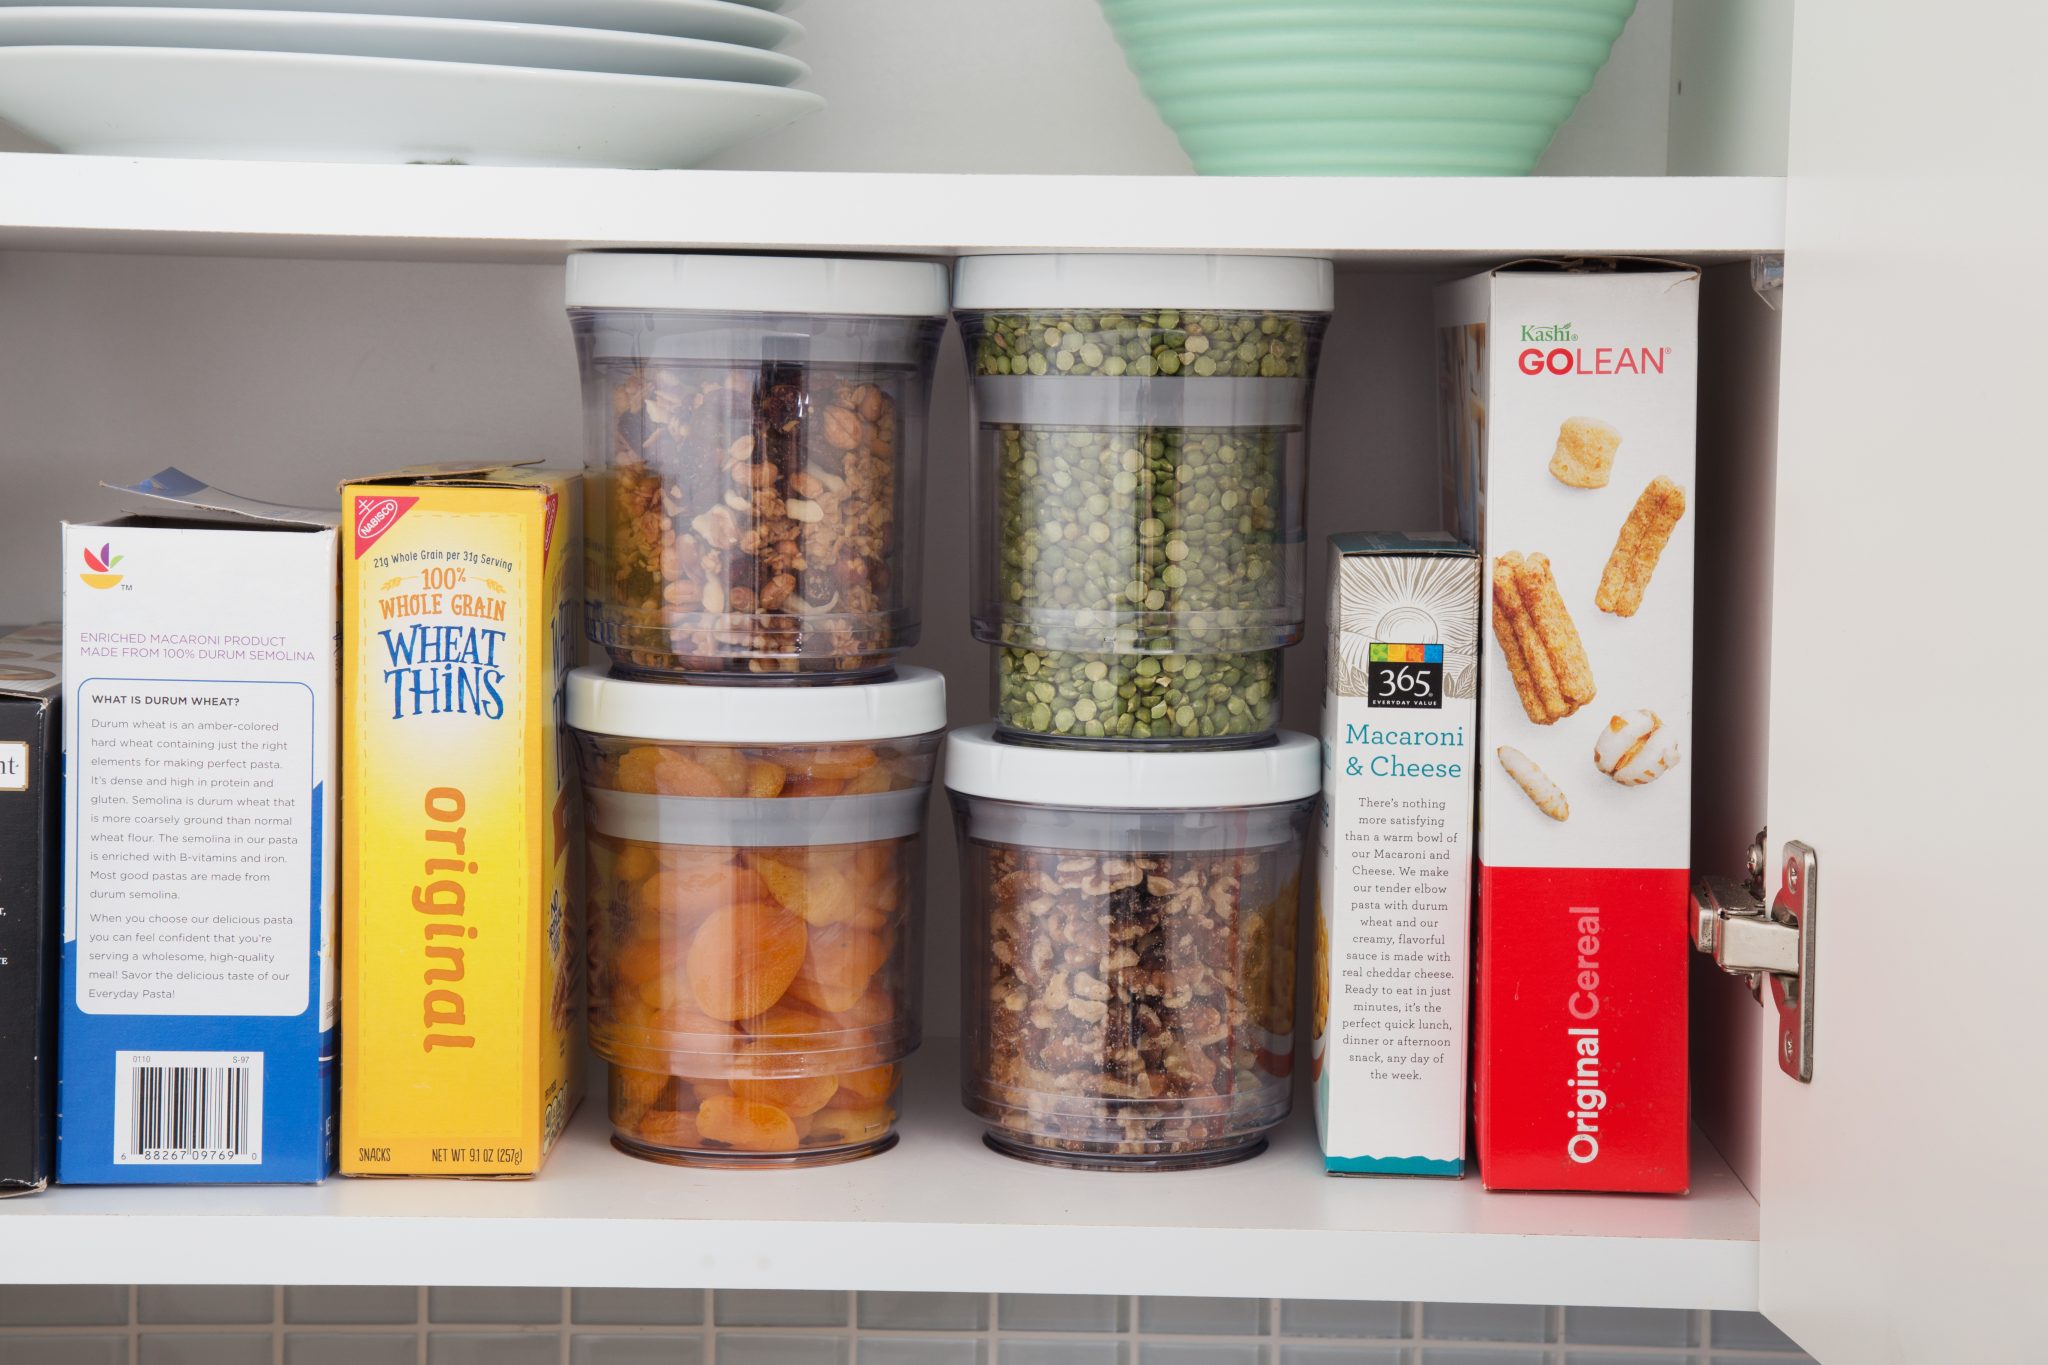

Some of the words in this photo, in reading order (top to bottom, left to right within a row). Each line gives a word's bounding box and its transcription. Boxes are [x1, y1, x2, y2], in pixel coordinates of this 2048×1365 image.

[360, 502, 395, 536] NABISCO
[373, 557, 389, 569] 21g
[391, 551, 418, 565] Whole
[420, 550, 443, 561] Grain
[446, 551, 460, 562] per
[463, 551, 478, 565] 31g
[480, 553, 513, 573] Serving
[420, 567, 467, 591] 100%
[379, 593, 443, 621] WHOLE
[451, 593, 507, 622] GRAIN
[80, 632, 147, 644] ENRICHED
[150, 633, 220, 646] MACARONI
[224, 635, 287, 647] PRODUCT
[377, 623, 506, 669] WHEAT
[80, 646, 119, 657] MADE
[122, 647, 160, 658] FROM
[162, 648, 195, 659] 100%
[198, 649, 246, 662] DURUM
[249, 650, 316, 662] SEMOLINA
[91, 694, 128, 705] WHAT
[130, 695, 142, 705] IS
[144, 695, 188, 706] DURUM
[190, 696, 241, 707] WHEAT?
[91, 718, 129, 729] Durum
[132, 719, 167, 730] wheat
[169, 719, 178, 730] is
[180, 722, 195, 730] an
[197, 721, 279, 732] amber-colored
[1345, 723, 1465, 747] Macaroni
[91, 737, 116, 747] hard
[119, 738, 154, 748] wheat
[156, 739, 215, 751] containing
[217, 740, 238, 751] just
[240, 740, 259, 750] the
[262, 741, 288, 752] right
[90, 756, 142, 767] elements
[144, 757, 161, 767] for
[163, 758, 204, 770] making
[207, 758, 247, 770] perfect
[250, 760, 283, 771] pasta.
[1346, 756, 1363, 777] &
[1370, 755, 1462, 778] Cheese
[1358, 796, 1399, 808] There's
[1401, 797, 1446, 812] nothing
[1358, 817, 1387, 825] more
[1390, 814, 1445, 828] satisfying
[1344, 830, 1370, 842] than
[1373, 834, 1380, 842] a
[1383, 834, 1414, 843] warm
[1416, 831, 1443, 843] bowl
[1446, 832, 1459, 844] of
[1351, 851, 1371, 859] our
[1373, 848, 1427, 860] Macaroni
[1429, 848, 1451, 861] and
[90, 870, 117, 880] Most
[119, 871, 149, 882] good
[152, 872, 188, 882] pastas
[190, 873, 208, 881] are
[210, 872, 242, 882] made
[244, 871, 271, 882] from
[1351, 864, 1396, 877] Cheese.
[1398, 866, 1417, 877] We
[1419, 865, 1449, 878] make
[89, 889, 126, 899] durum
[128, 890, 180, 900] semolina.
[1352, 881, 1373, 893] our
[1375, 882, 1412, 894] tender
[1414, 882, 1447, 894] elbow
[1351, 901, 1381, 912] pasta
[1383, 899, 1409, 911] with
[1411, 899, 1449, 912] durum
[89, 913, 122, 923] When
[124, 915, 145, 925] you
[148, 913, 188, 924] choose
[190, 916, 210, 924] our
[212, 914, 261, 925] delicious
[263, 915, 293, 927] pasta
[411, 786, 479, 1054] original
[1359, 915, 1393, 927] wheat
[1396, 916, 1417, 928] and
[1419, 920, 1439, 928] our
[89, 934, 110, 944] you
[112, 934, 132, 942] can
[135, 932, 155, 942] feel
[158, 932, 211, 943] confident
[213, 933, 236, 943] that
[238, 934, 272, 945] you're
[1352, 935, 1396, 947] creamy,
[1398, 933, 1446, 945] flavorful
[88, 951, 129, 963] serving
[131, 953, 139, 961] a
[141, 951, 207, 962] wholesome,
[209, 951, 275, 964] high-quality
[1345, 952, 1378, 961] sauce
[1380, 951, 1391, 961] is
[1393, 950, 1424, 962] made
[1426, 951, 1452, 962] with
[1568, 906, 1600, 1020] Cereal
[88, 970, 118, 980] meal!
[121, 970, 153, 980] Savor
[155, 970, 174, 980] the
[176, 970, 225, 981] delicious
[227, 972, 255, 981] taste
[257, 971, 270, 981] of
[271, 973, 290, 981] our
[1342, 965, 1363, 978] real
[1365, 966, 1412, 979] cheddar
[1413, 967, 1455, 979] cheese.
[88, 988, 139, 1000] Everyday
[142, 989, 175, 999] Pasta!
[1344, 983, 1379, 997] Ready
[1381, 986, 1393, 995] to
[1396, 987, 1413, 996] eat
[1416, 985, 1428, 996] in
[1429, 985, 1452, 998] just
[1353, 1001, 1402, 1014] minutes,
[1404, 1000, 1421, 1013] it's
[1423, 1001, 1442, 1013] the
[1341, 1016, 1381, 1030] perfect
[1384, 1018, 1416, 1032] quick
[1418, 1018, 1452, 1032] lunch,
[1342, 1033, 1380, 1046] dinner
[1382, 1038, 1395, 1046] or
[1397, 1035, 1451, 1047] afternoon
[132, 1055, 151, 1064] 0110
[1348, 1051, 1384, 1064] snack,
[1386, 1055, 1408, 1065] any
[1410, 1052, 1431, 1066] day
[1432, 1052, 1445, 1064] of
[1370, 1068, 1388, 1080] the
[1391, 1069, 1424, 1081] week.
[1567, 1027, 1607, 1164] Original
[121, 1152, 127, 1161] 6
[144, 1150, 187, 1161] 88267
[191, 1150, 235, 1161] 09769
[251, 1152, 258, 1161] 0
[358, 1147, 391, 1163] SNACKS
[431, 1147, 448, 1163] NET
[451, 1147, 466, 1163] WT
[469, 1147, 480, 1163] 9.1
[483, 1147, 494, 1164] OZ
[496, 1147, 523, 1166] (257g)
